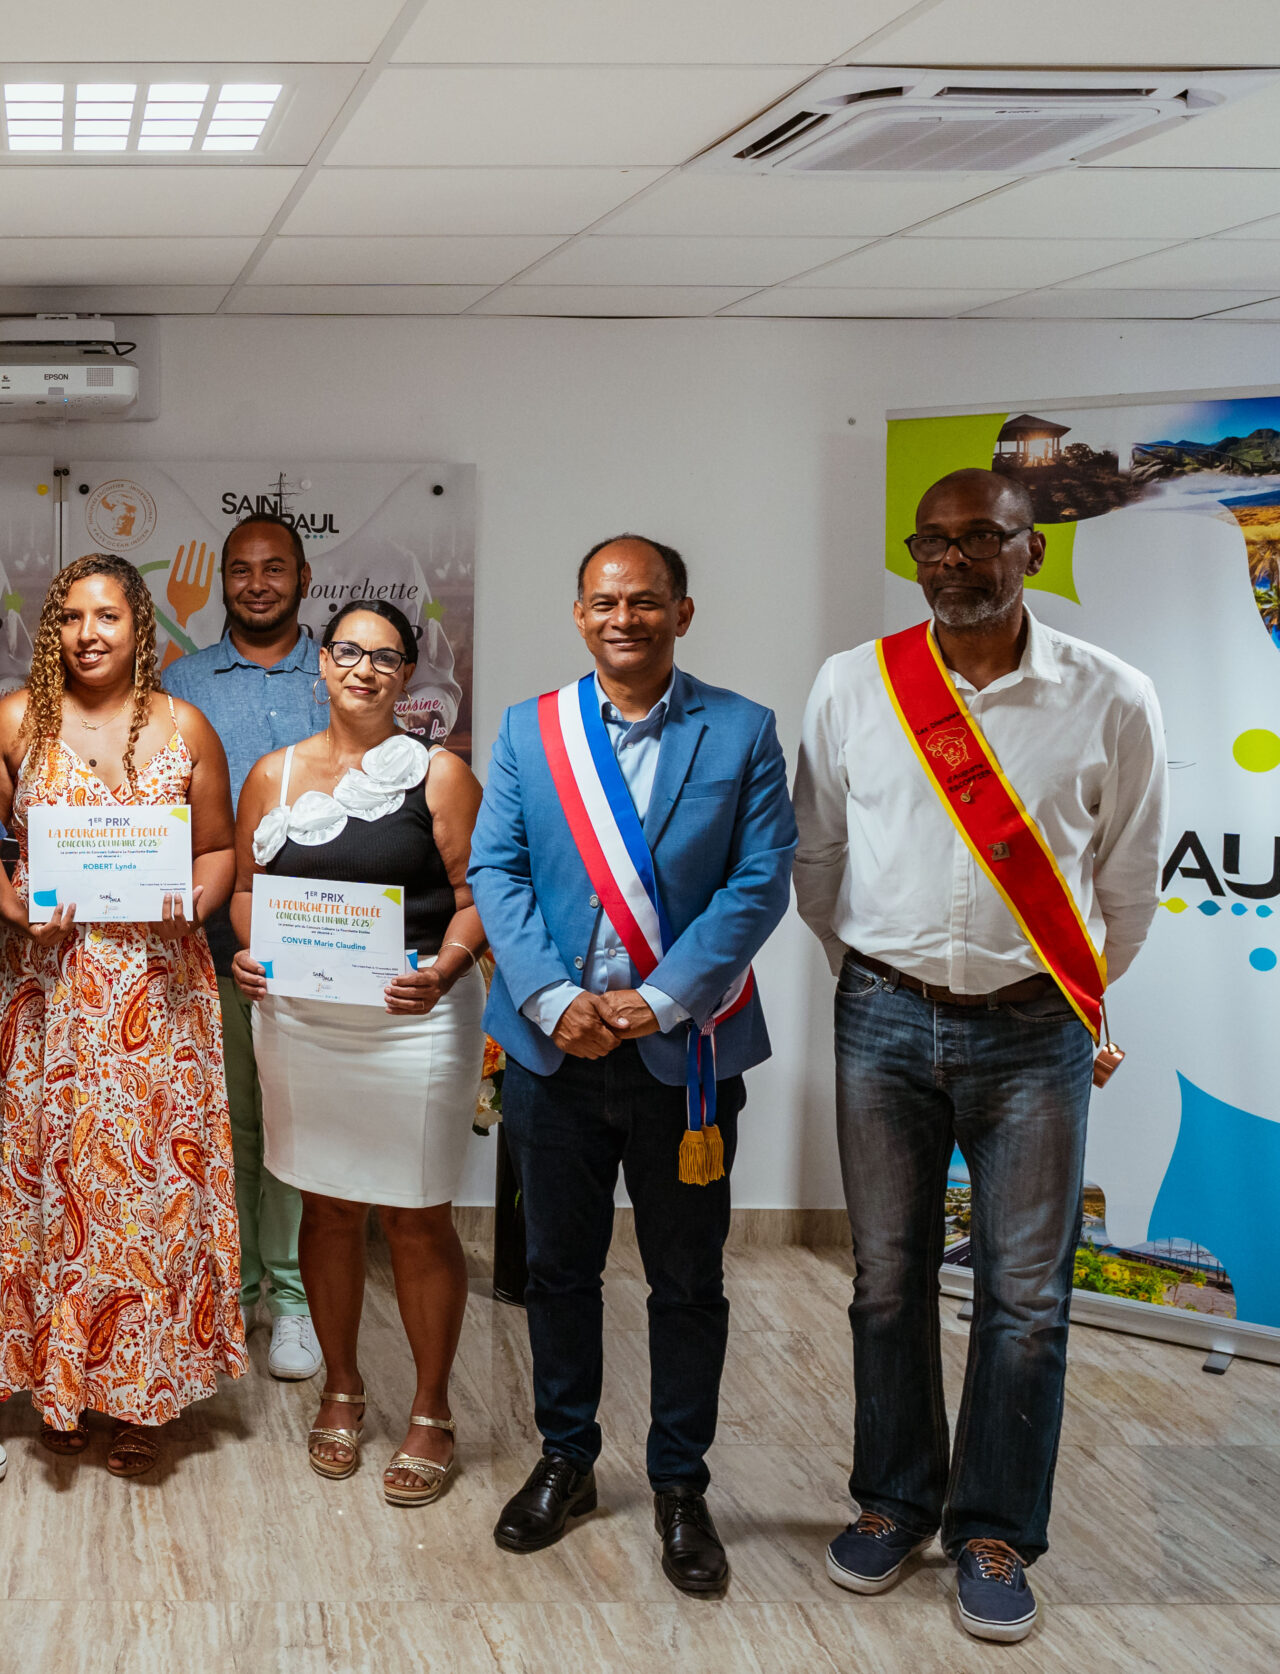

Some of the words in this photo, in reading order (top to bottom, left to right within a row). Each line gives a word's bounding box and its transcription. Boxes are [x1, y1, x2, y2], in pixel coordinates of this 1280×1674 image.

[310, 578, 418, 600] ourchette
[930, 711, 960, 729] Disciples
[106, 817, 131, 827] PRIX
[49, 828, 62, 839] LA
[65, 828, 128, 839] FOURCHETTE
[131, 825, 169, 837] ÉTOILÉE
[57, 840, 96, 849] CONCOURS
[98, 839, 137, 848] CULINAIRE
[139, 839, 158, 847] 2025
[115, 862, 137, 871] Lynda
[320, 892, 345, 903] PRIX
[269, 898, 281, 909] LA
[283, 899, 341, 915] FOURCHETTE
[344, 903, 382, 918] ÉTOILÉE
[276, 911, 311, 923] CONCOURS
[313, 915, 349, 926] CULINAIRE
[352, 918, 370, 928] 2025
[282, 936, 312, 946] CONVER
[314, 939, 334, 948] Marie
[336, 941, 367, 951] Claudine
